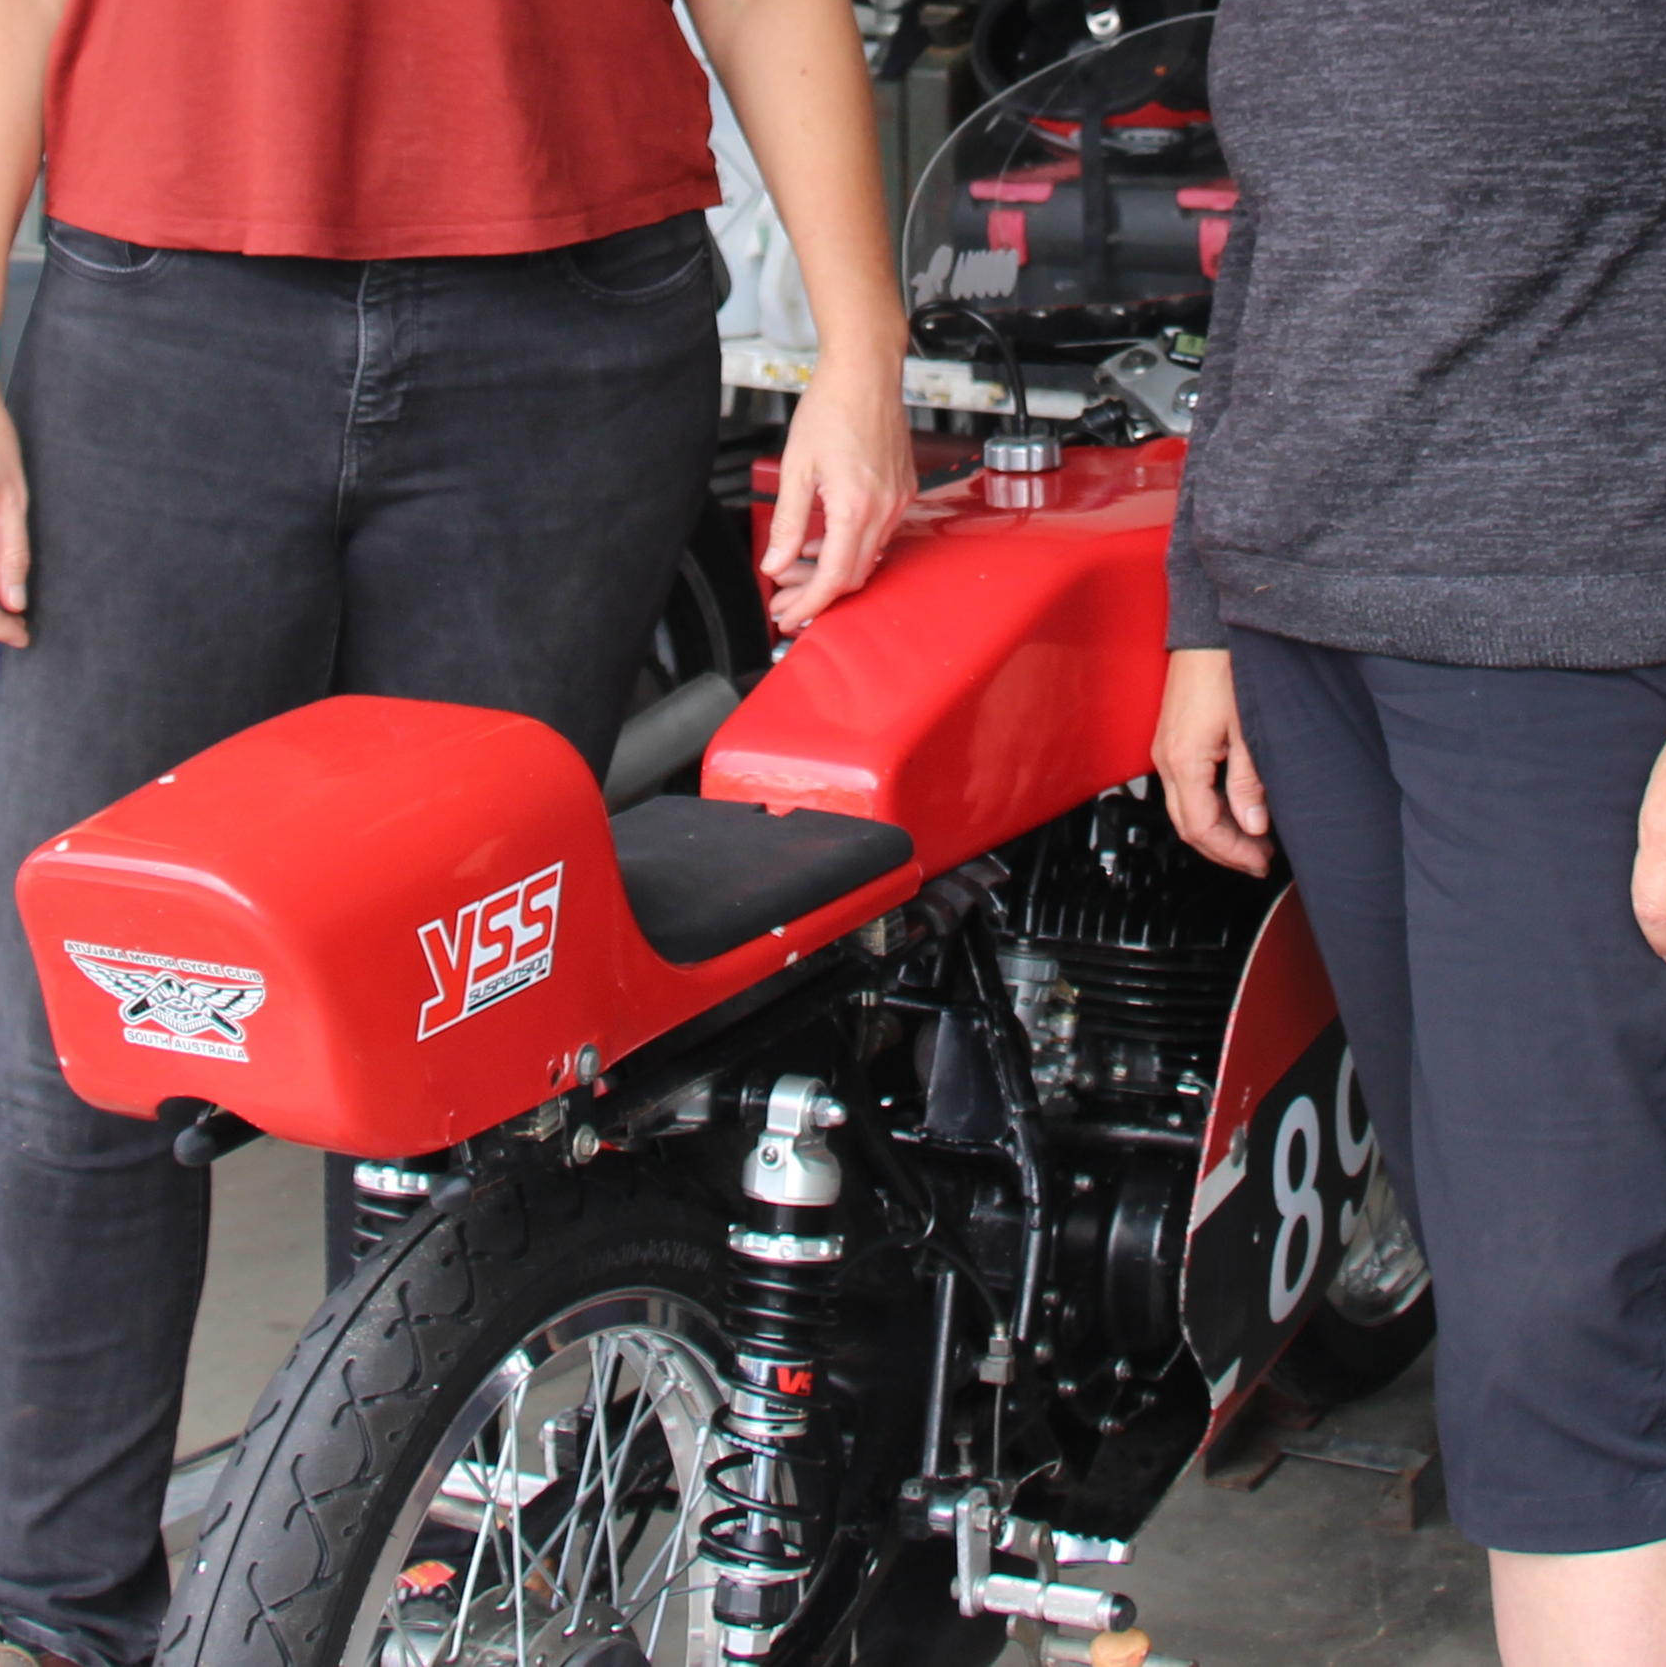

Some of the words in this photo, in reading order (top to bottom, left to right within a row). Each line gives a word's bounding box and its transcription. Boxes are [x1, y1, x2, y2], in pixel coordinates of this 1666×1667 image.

[66, 942, 126, 961] ATUJARA
[129, 951, 178, 969] MOTOR
[180, 960, 224, 976] CYCLE
[226, 967, 262, 983] CLUB
[420, 864, 561, 1039] YSS
[126, 1029, 171, 1048] SOUTH
[173, 1038, 247, 1061] AUSTRALIA
